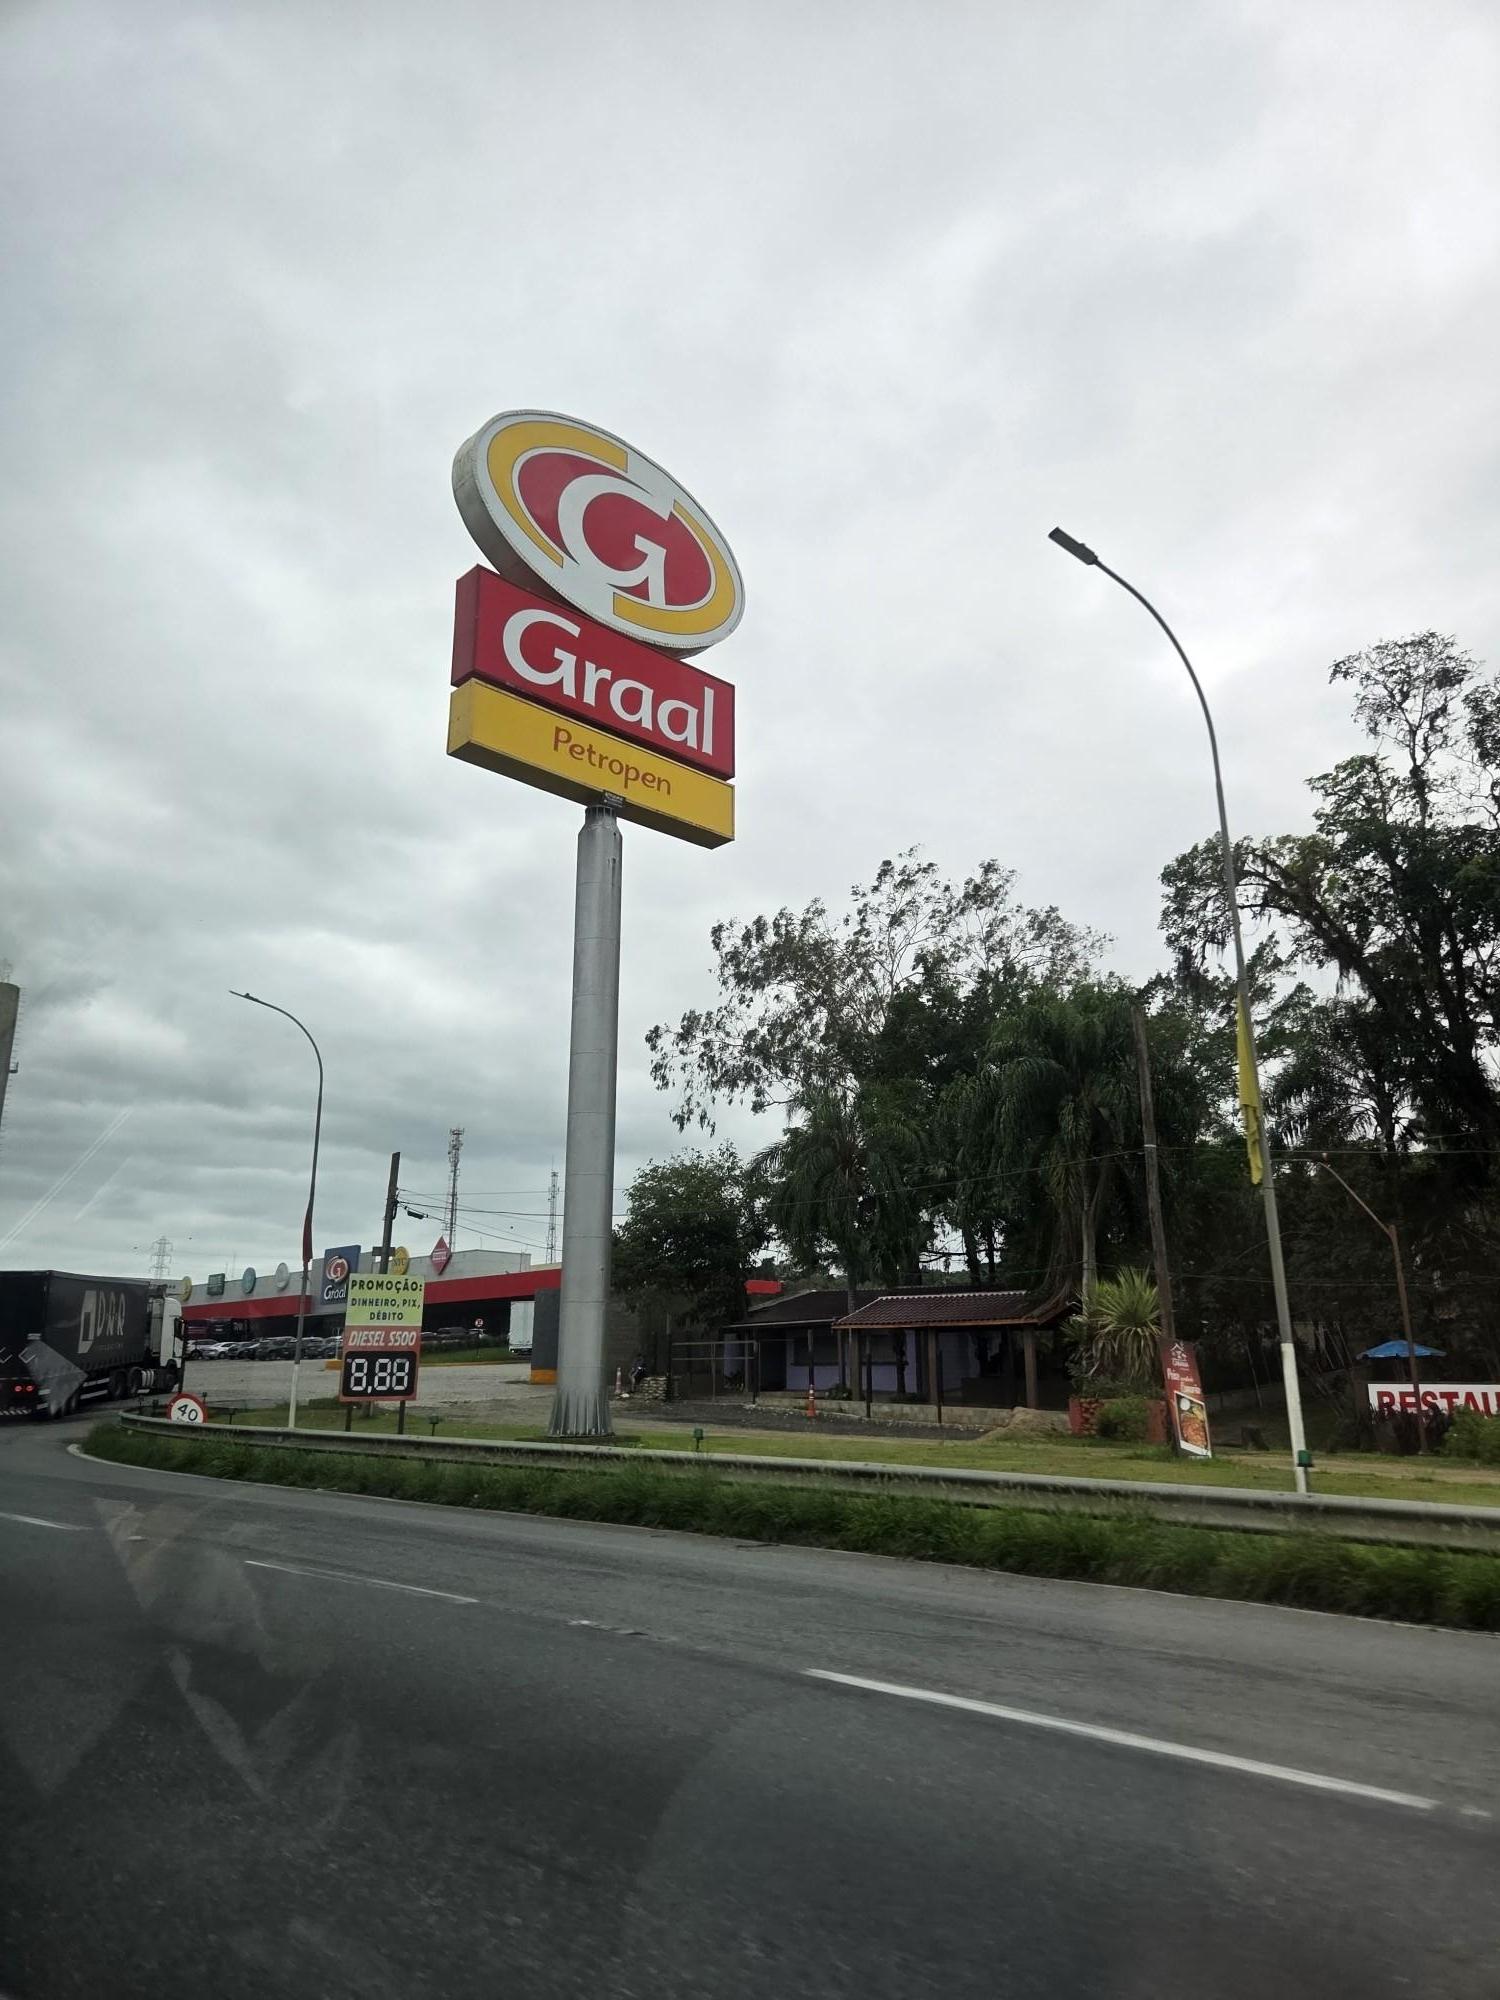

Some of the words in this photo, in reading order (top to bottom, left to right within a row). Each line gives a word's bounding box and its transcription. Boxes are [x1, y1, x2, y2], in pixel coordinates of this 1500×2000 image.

[502, 608, 715, 756] Graal
[552, 726, 672, 796] Petropen
[323, 1283, 346, 1300] Graal
[350, 1279, 423, 1293] PROMOÇÃO:
[350, 1297, 400, 1308] DINHEIRO,
[402, 1298, 421, 1309] PIX,
[369, 1311, 404, 1321] DÉBITO
[348, 1331, 385, 1346] DIESEL
[387, 1331, 417, 1346] S500
[350, 1358, 410, 1394] 8,88
[177, 1404, 198, 1421] 40
